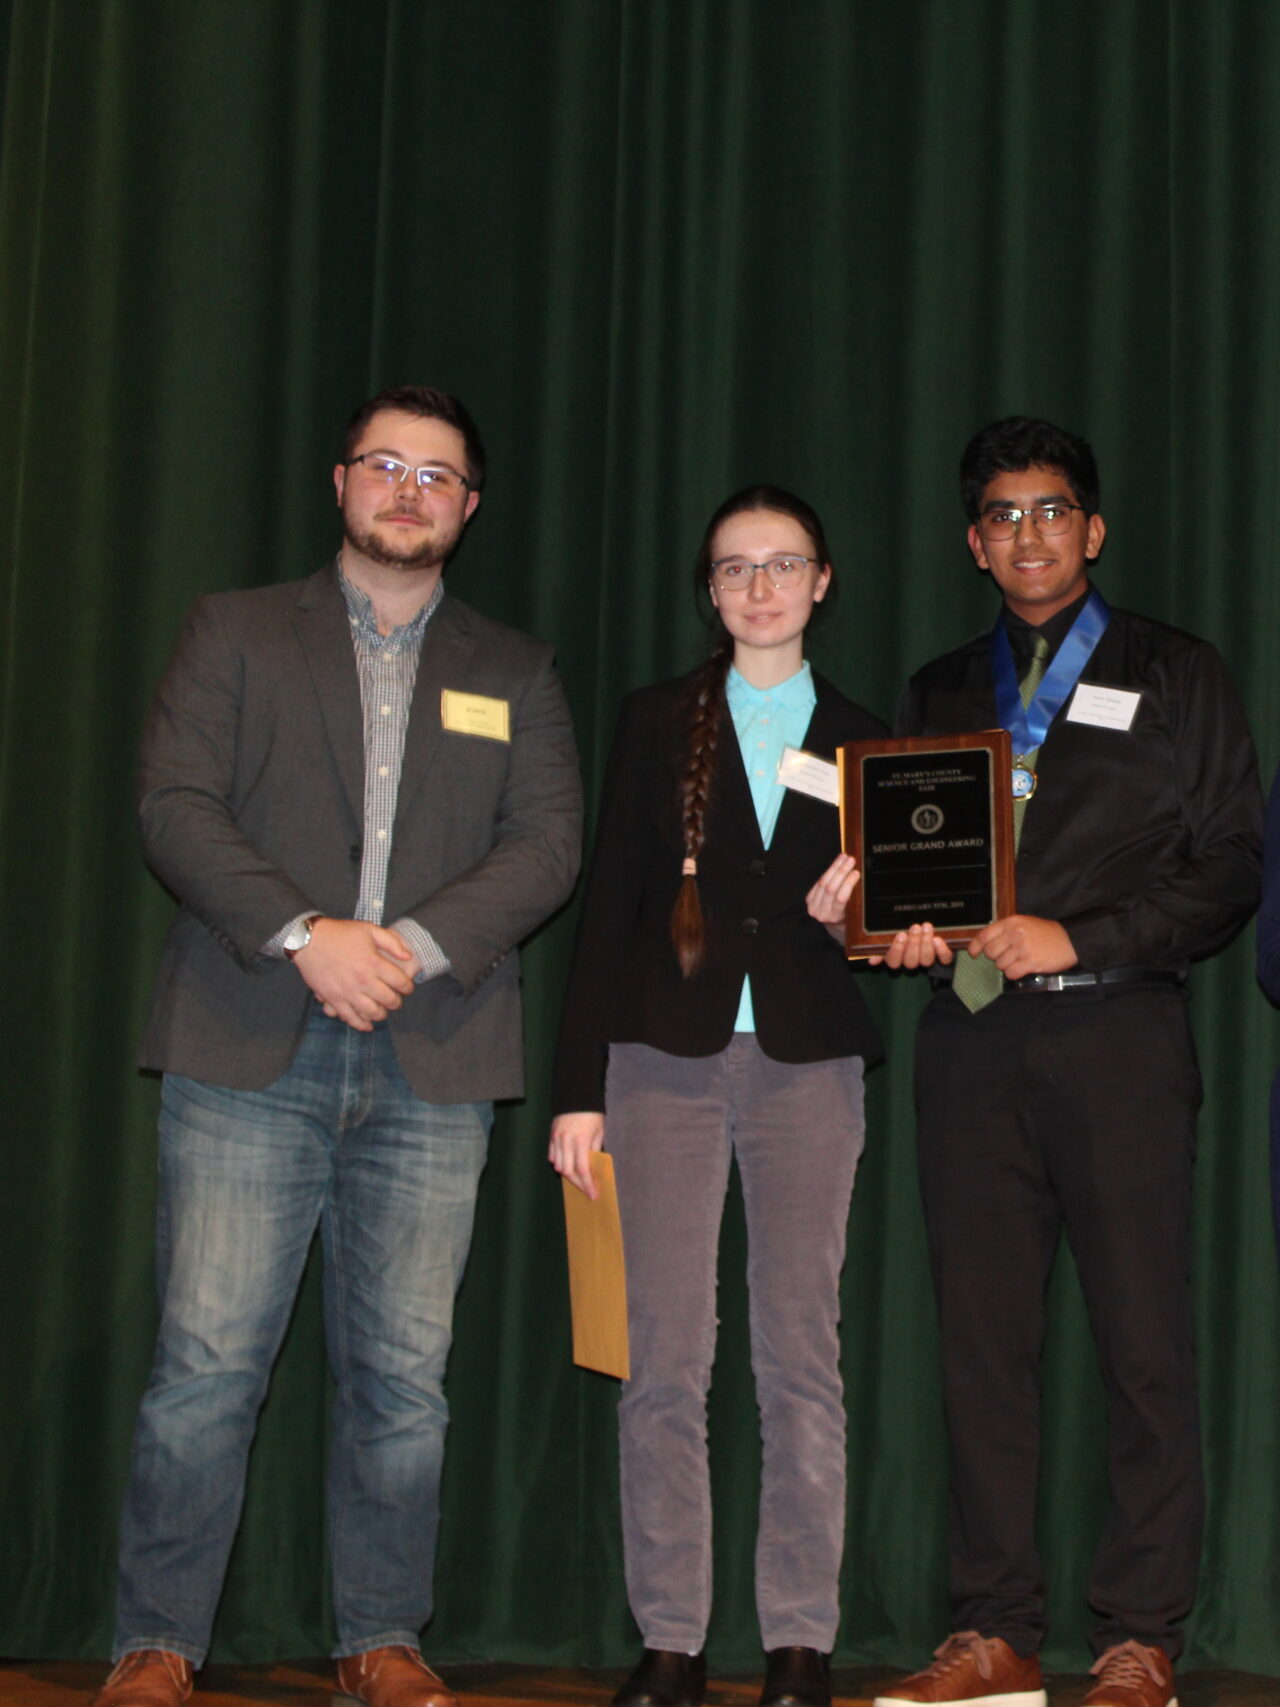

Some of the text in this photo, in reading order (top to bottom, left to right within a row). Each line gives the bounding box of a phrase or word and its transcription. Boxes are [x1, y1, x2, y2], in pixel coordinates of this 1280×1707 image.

[871, 838, 984, 854] SENIOR GRAND AWARD
